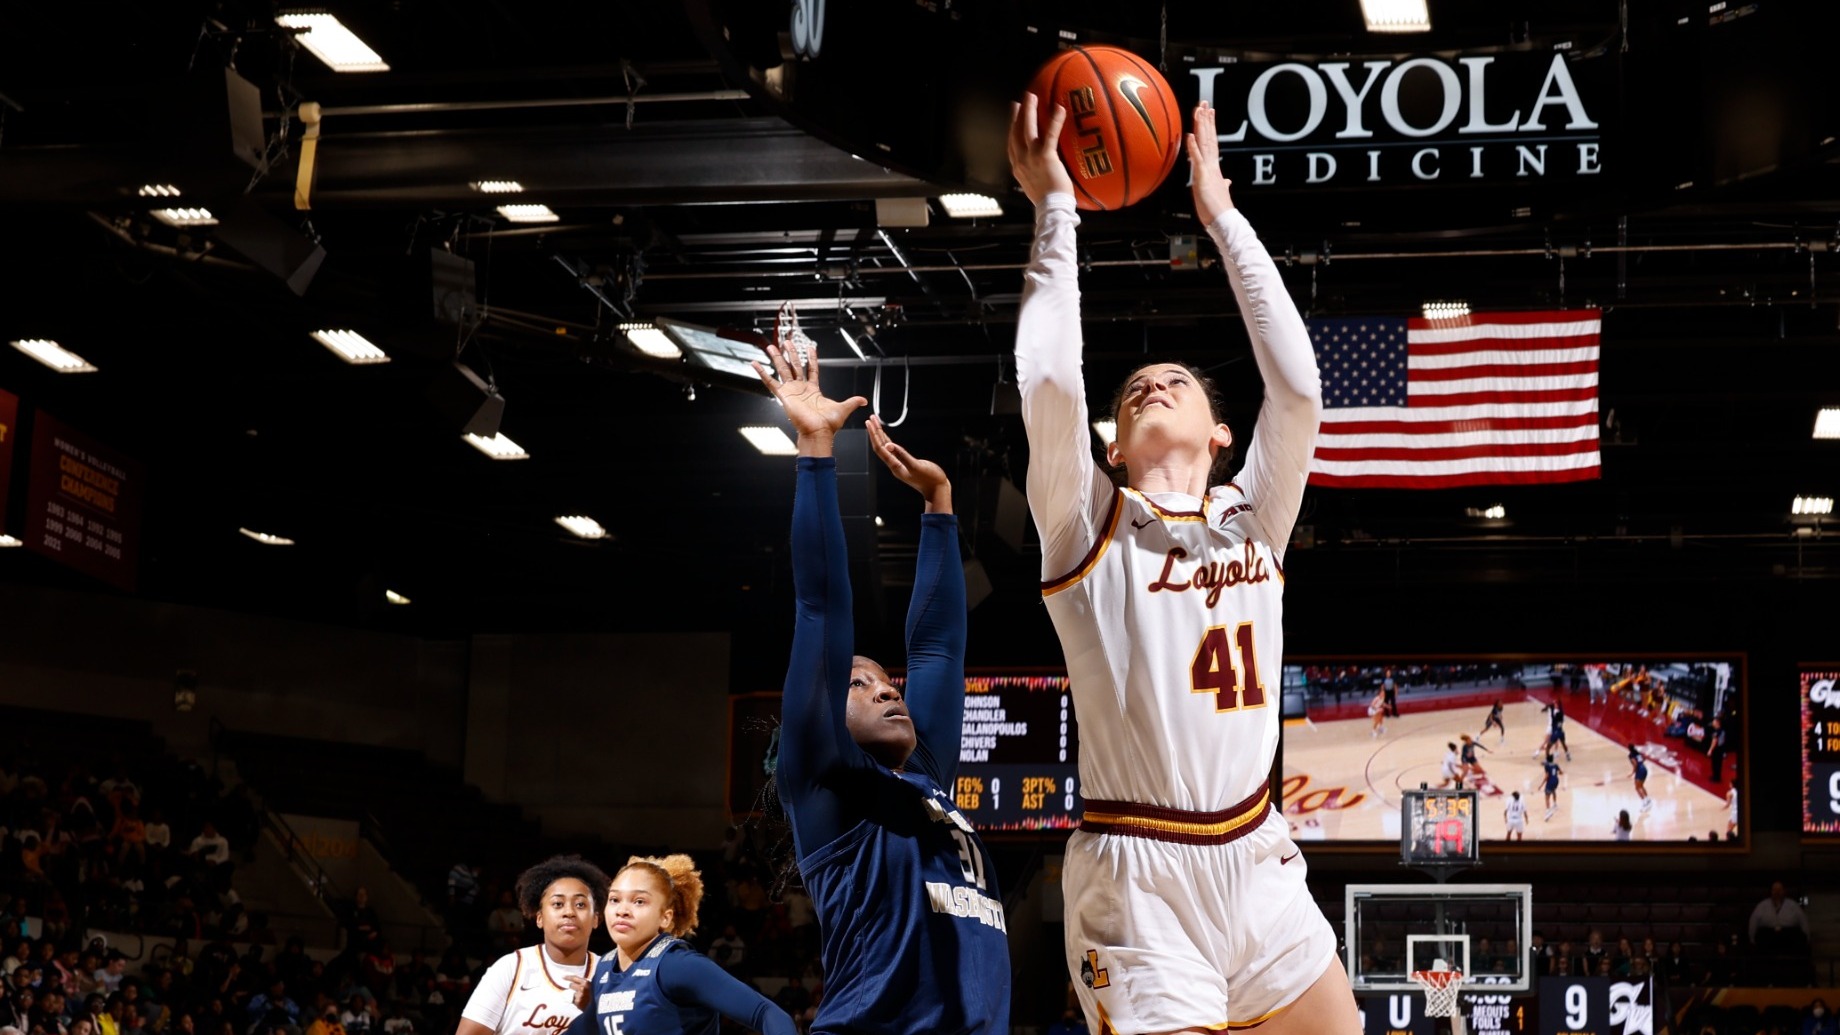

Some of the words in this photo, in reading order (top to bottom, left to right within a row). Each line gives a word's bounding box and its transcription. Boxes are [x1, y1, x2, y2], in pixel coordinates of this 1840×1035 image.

[1189, 53, 1599, 143] LOYOLA
[1068, 85, 1114, 179] ELITE
[1186, 143, 1602, 187] EDICINE
[59, 454, 120, 496] CONFERENCE
[60, 473, 115, 513] CHAMPIONS
[1147, 537, 1270, 609] Loyola
[1189, 620, 1267, 714] 41
[1061, 694, 1068, 708] 0
[1060, 708, 1068, 721] 0
[1060, 722, 1067, 735] 0
[960, 736, 997, 749] CHIVERS
[1059, 735, 1067, 749] 0
[959, 749, 989, 762] NOLAN
[1059, 749, 1066, 763] 0
[957, 777, 983, 793] FG%
[991, 777, 1001, 794] 0
[1022, 777, 1056, 794] 3PT%
[1065, 777, 1074, 794] 0
[956, 794, 980, 809] REB
[992, 794, 1000, 810] 1
[1022, 794, 1045, 809] AST
[1064, 794, 1074, 811] 0
[522, 1003, 572, 1035] Loy
[1467, 1005, 1510, 1019] MEOUTS
[1565, 984, 1588, 1030] 9
[1472, 1017, 1502, 1030] FOULS
